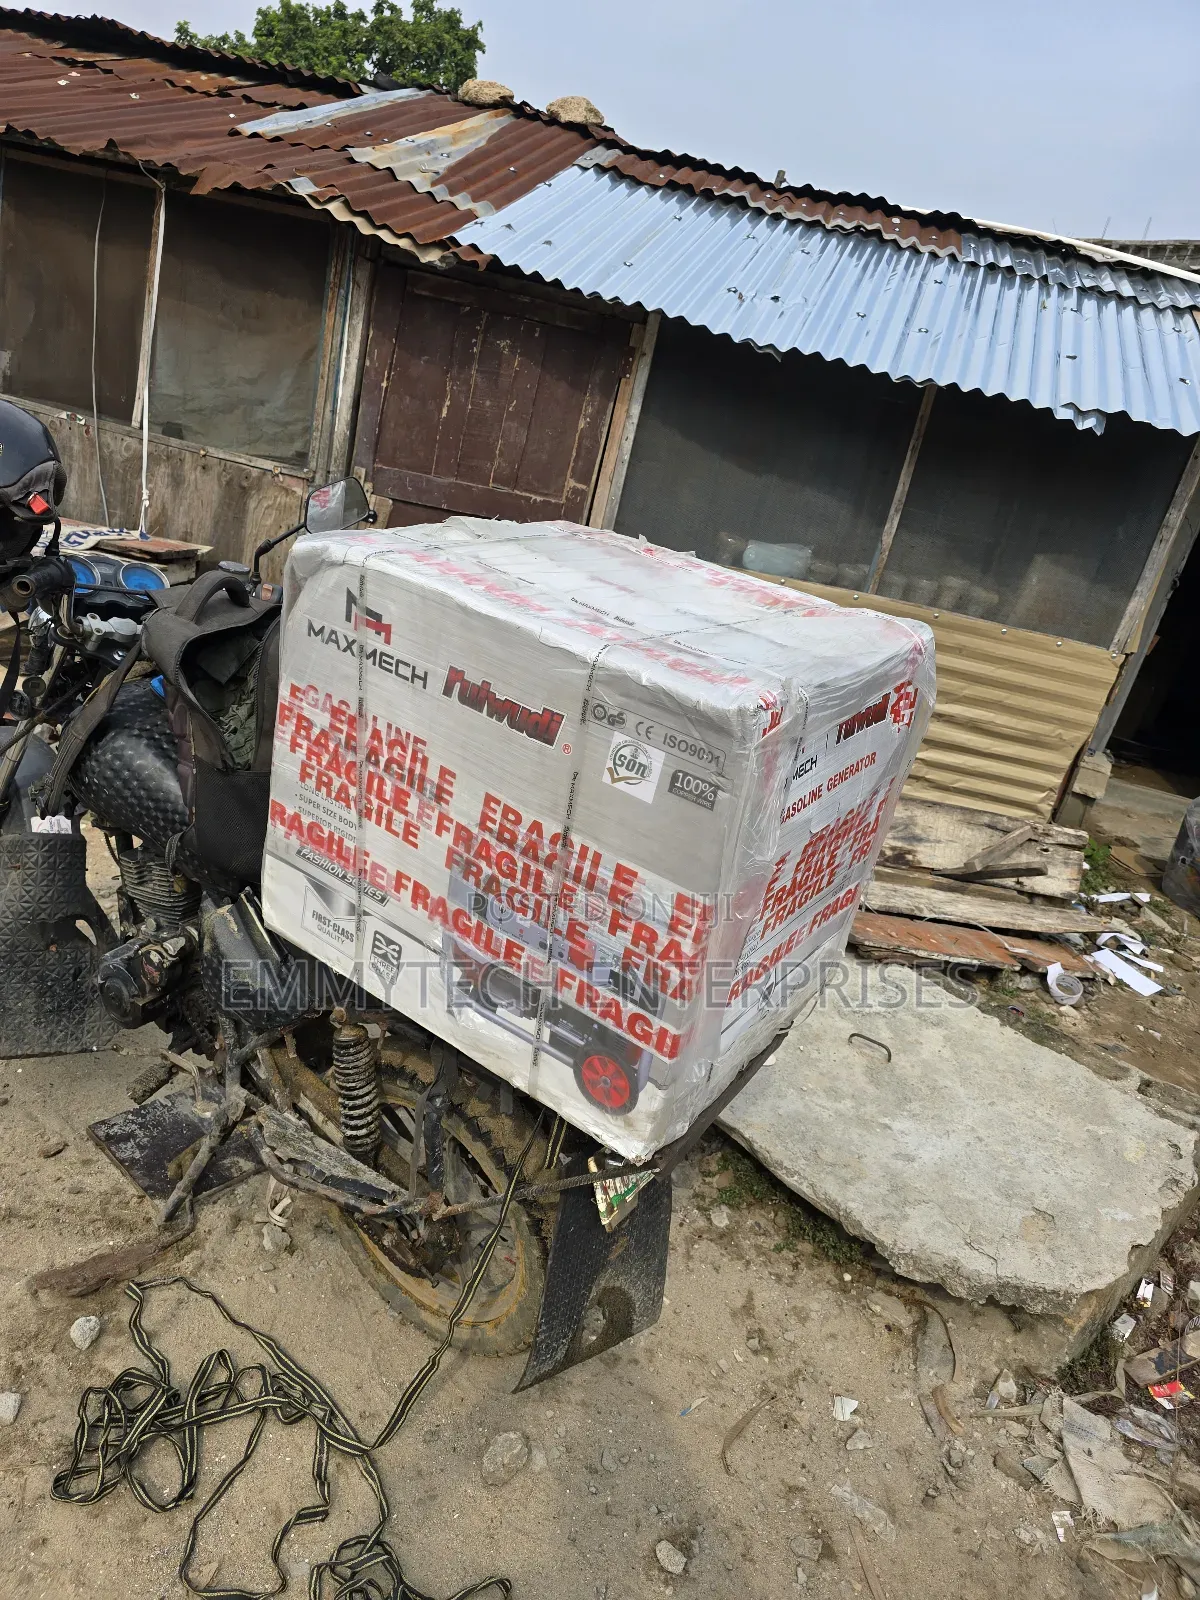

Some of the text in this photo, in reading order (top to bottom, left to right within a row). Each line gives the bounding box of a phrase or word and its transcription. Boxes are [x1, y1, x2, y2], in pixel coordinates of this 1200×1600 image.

[307, 619, 428, 690] MAXMECH
[305, 684, 427, 752] GASLINE
[662, 732, 721, 767] ISO9001
[674, 772, 715, 800] 100%
[826, 751, 877, 792] GENERATOR
[298, 794, 321, 812] SUPER
[321, 805, 338, 820] SIZE
[298, 807, 333, 834] SUPERIOR
[333, 825, 357, 844] RIGIDI
[300, 848, 345, 878] FASHION
[311, 909, 354, 943] FIRST-CLASS
[316, 923, 346, 945] QUALITY
[394, 870, 525, 973] FRAGILE
[371, 962, 396, 986] PHASE
[373, 954, 396, 972] THREE
